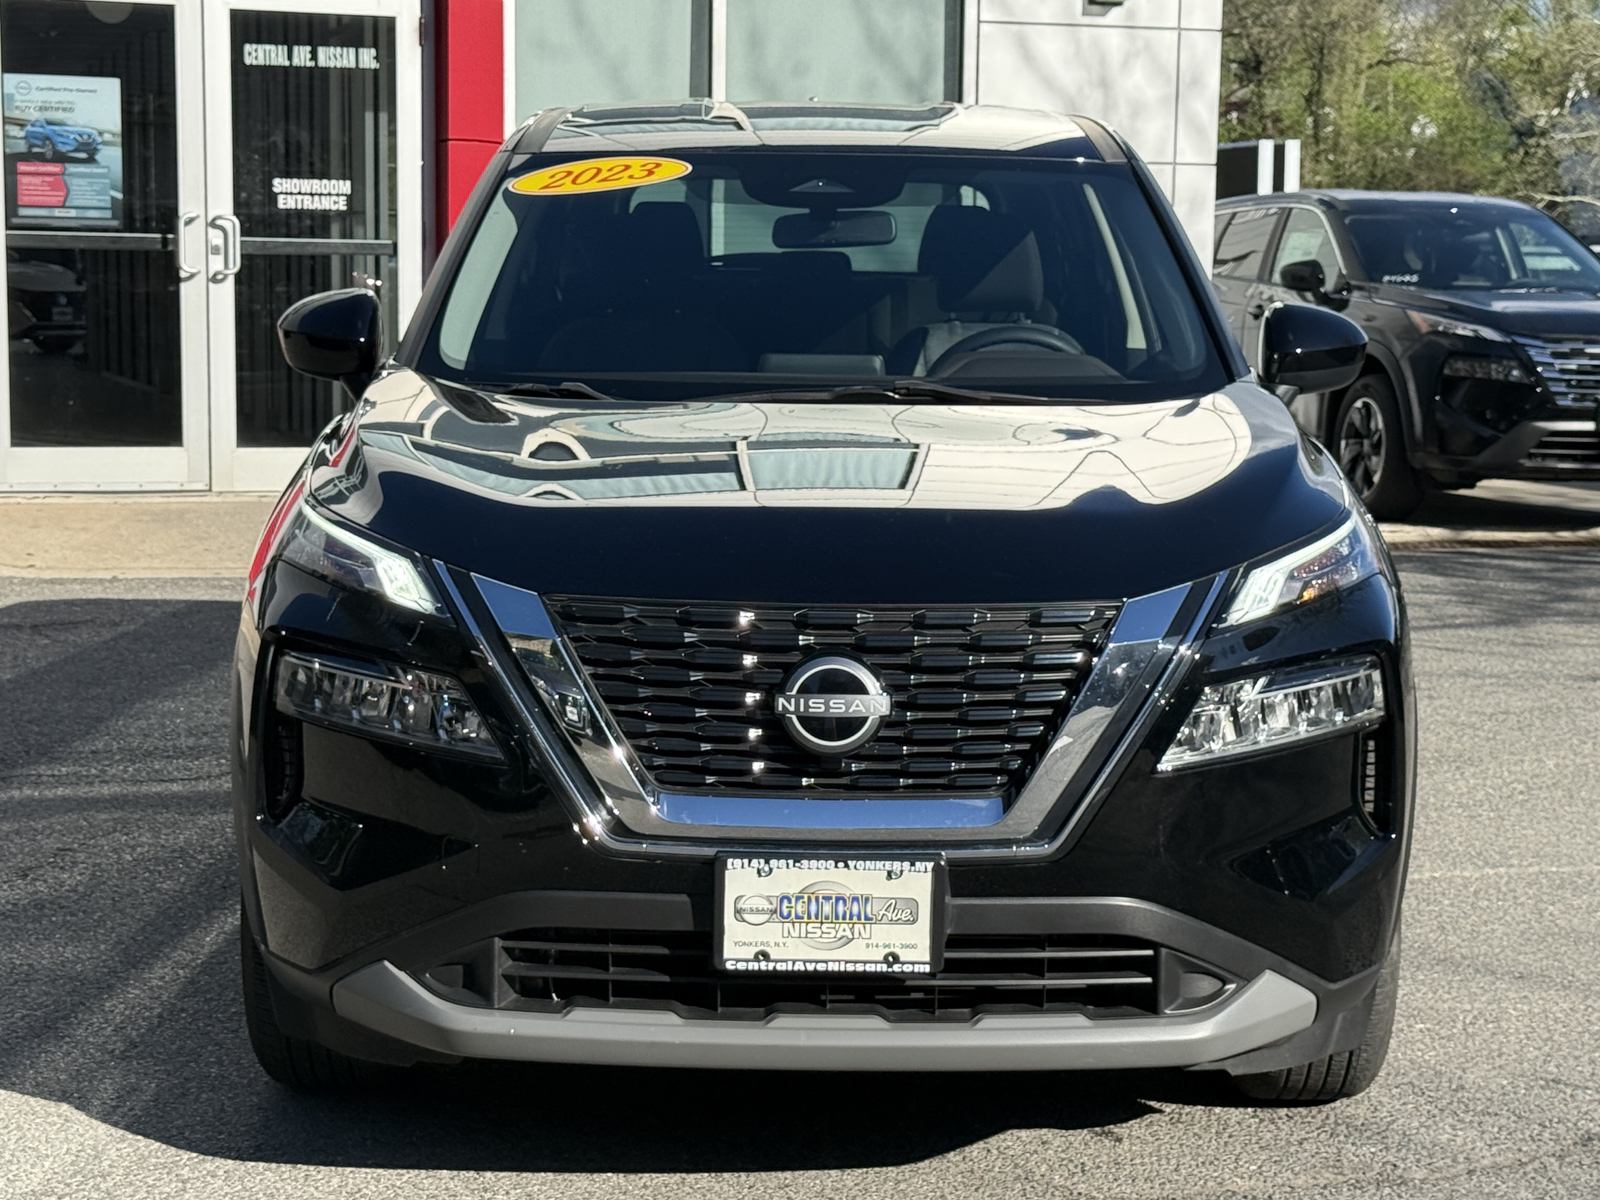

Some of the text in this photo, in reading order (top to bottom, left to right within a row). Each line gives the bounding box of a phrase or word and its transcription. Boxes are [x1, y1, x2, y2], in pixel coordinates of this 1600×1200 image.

[243, 43, 380, 70] CENTRAL AVE. NISSAN INC.
[539, 162, 662, 190] 2023
[271, 177, 352, 195] SHOWROOM
[277, 193, 348, 211] ENTRANCE
[778, 697, 887, 713] NISSAN
[769, 859, 836, 870] 961-3900
[777, 892, 915, 923] CENTRAL Ave.
[782, 922, 871, 939] NISSAN
[733, 940, 773, 948] YONKERS,
[865, 942, 918, 950] 914-961-3900
[725, 960, 931, 972] CentralAveNissan.com
